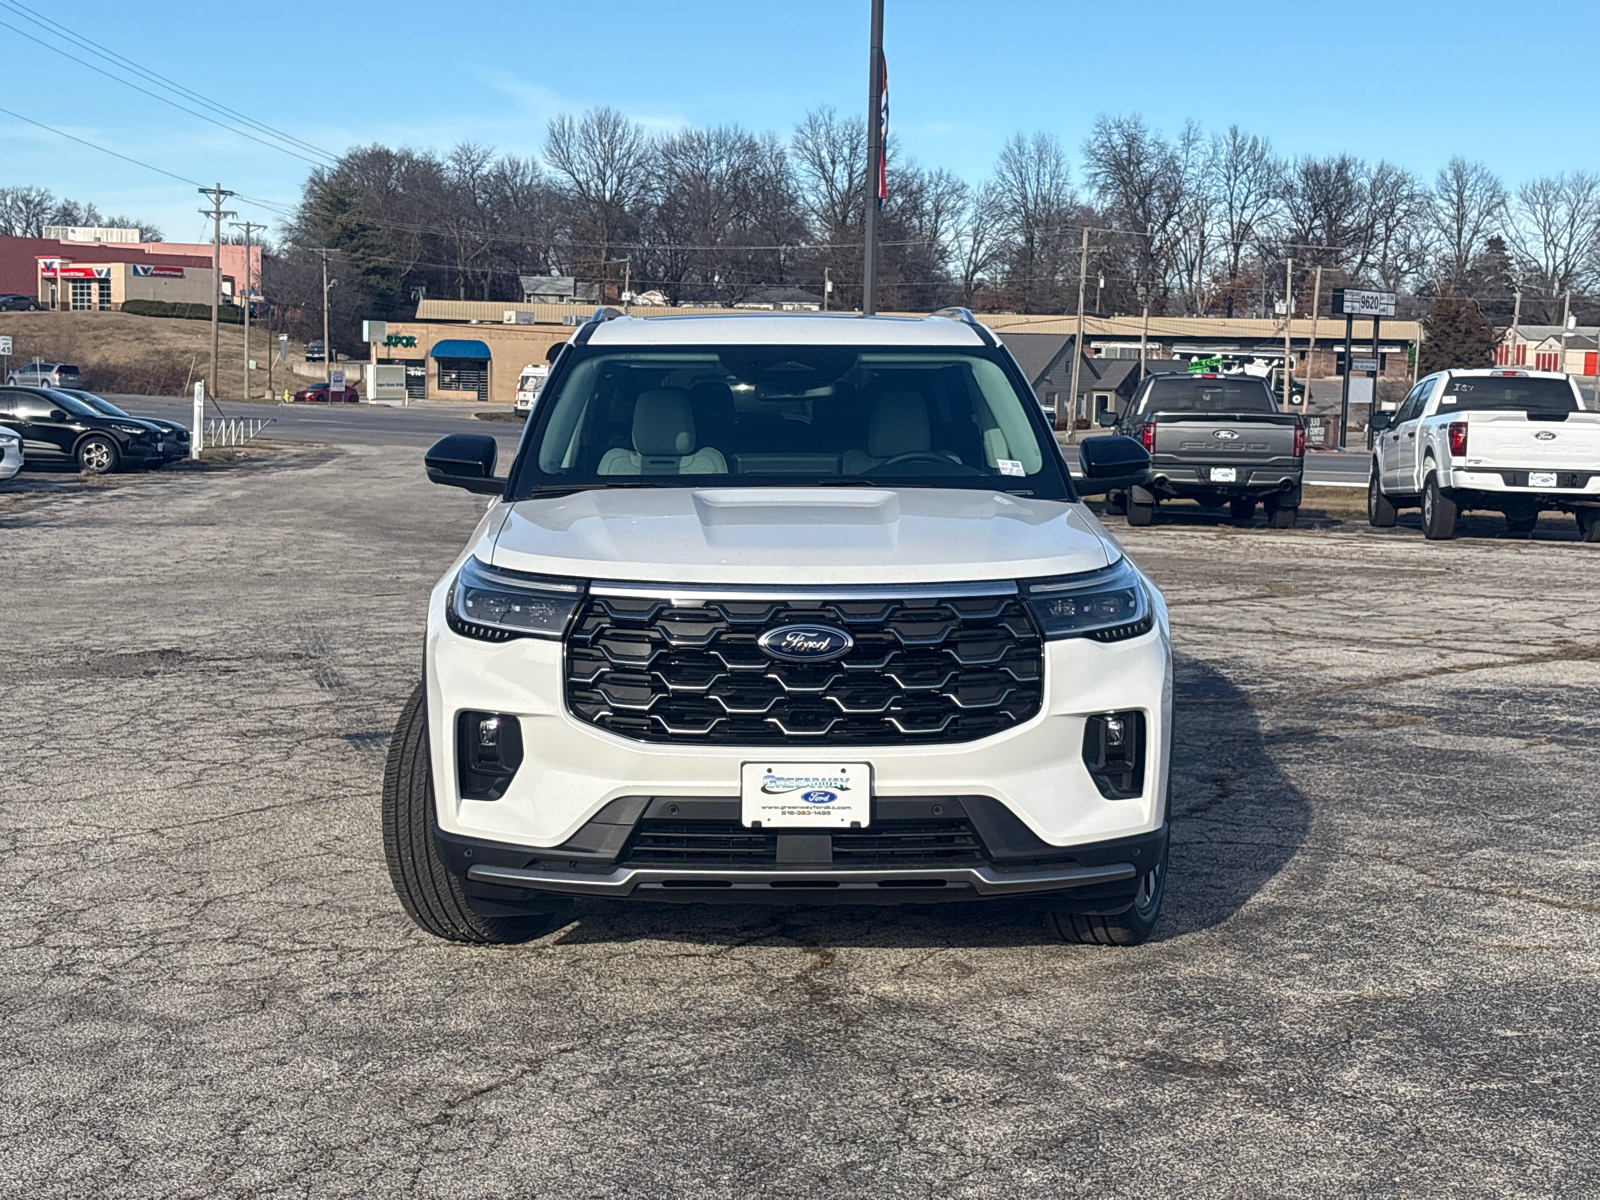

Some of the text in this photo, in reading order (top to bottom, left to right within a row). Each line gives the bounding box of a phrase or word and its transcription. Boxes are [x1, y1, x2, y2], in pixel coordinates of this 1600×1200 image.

[1361, 295, 1379, 310] 9620
[1310, 417, 1320, 427] 350
[1180, 441, 1270, 451] F-150
[781, 631, 831, 651] Ford
[808, 791, 830, 802] Ford
